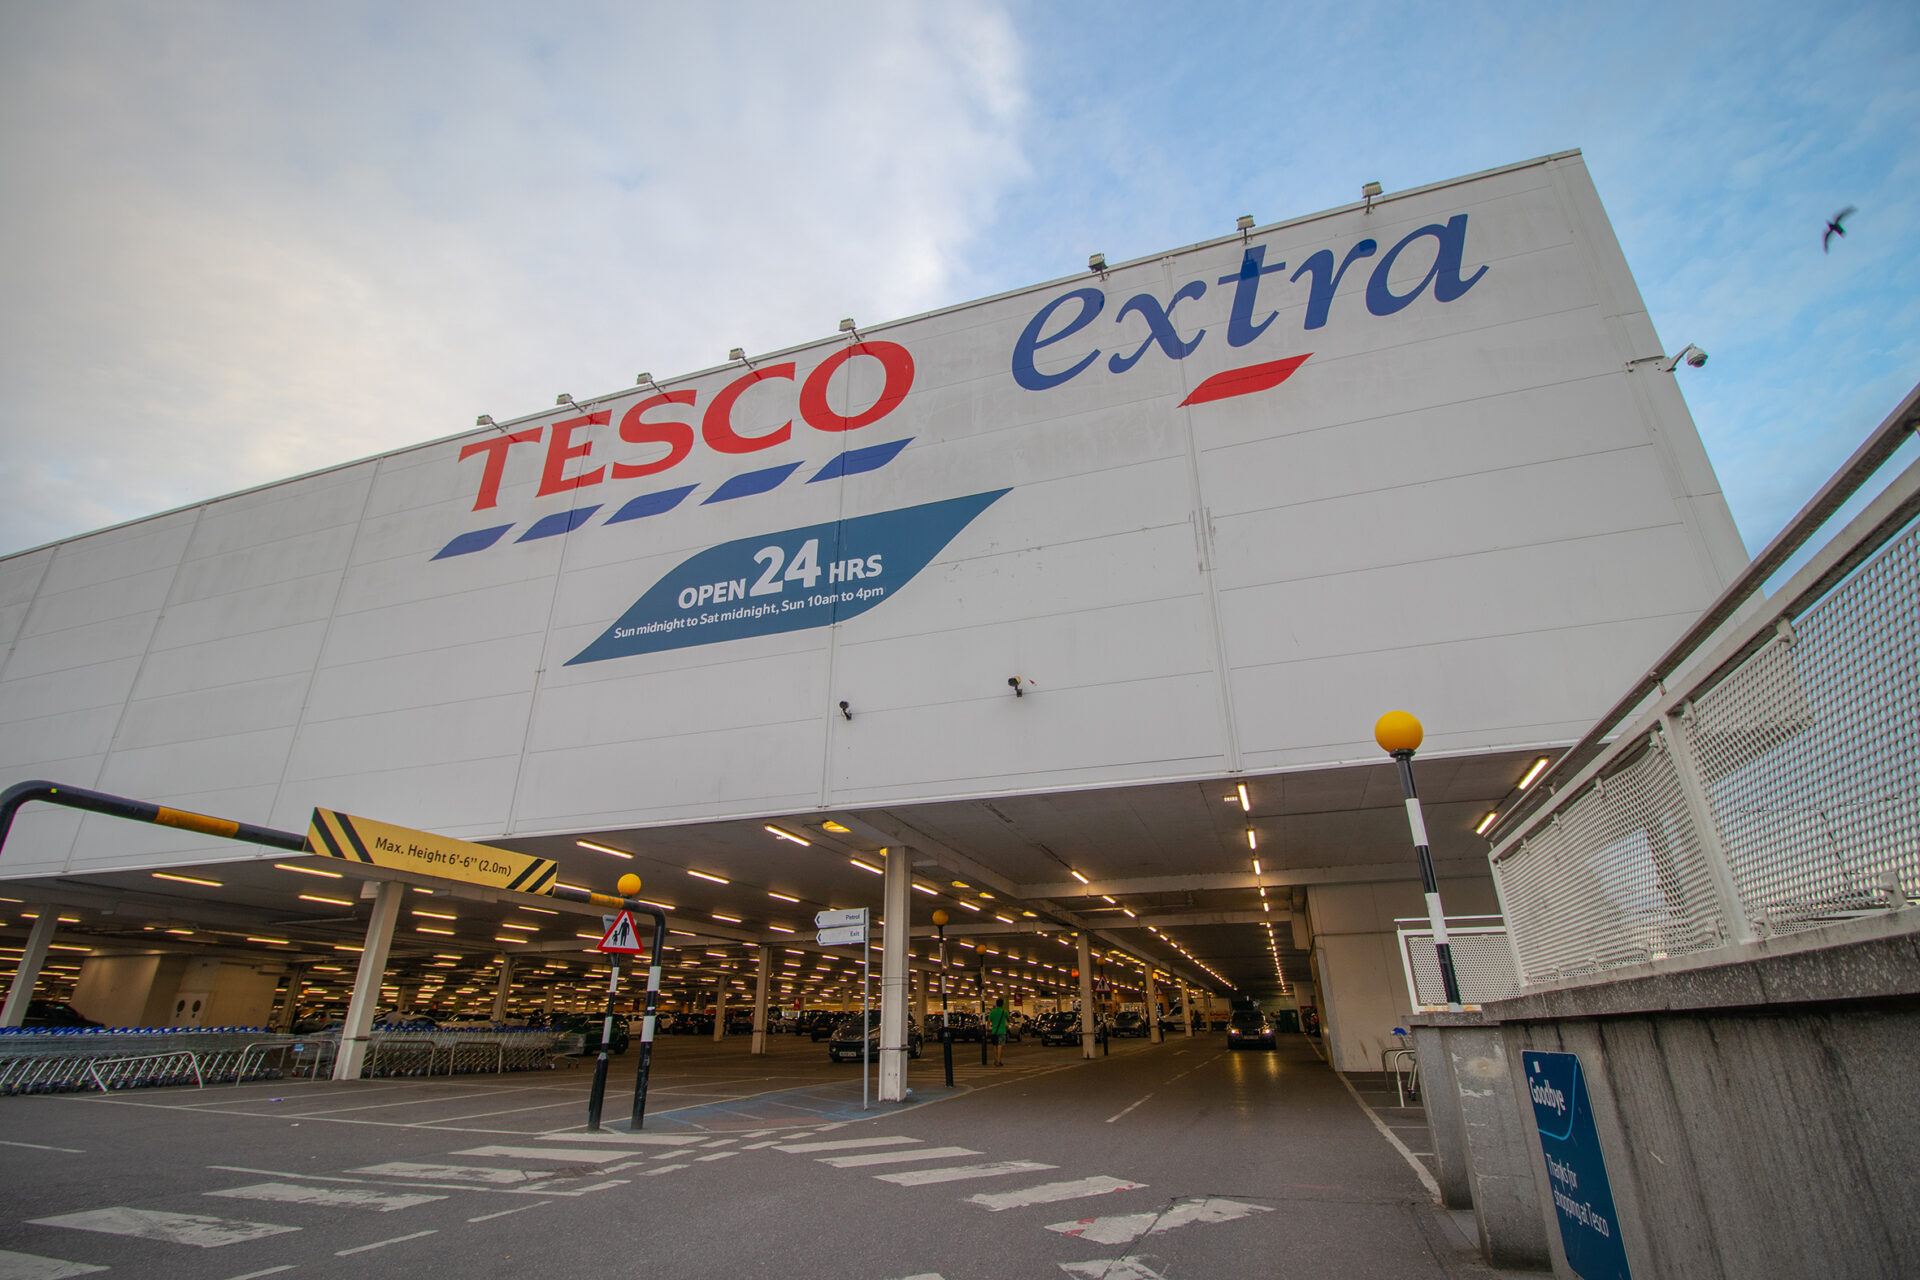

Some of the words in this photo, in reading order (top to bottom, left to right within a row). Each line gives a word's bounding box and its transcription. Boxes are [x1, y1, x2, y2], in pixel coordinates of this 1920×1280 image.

[457, 341, 915, 512] TESCO
[1011, 213, 1490, 391] extra
[678, 578, 747, 609] OPEN
[749, 538, 822, 597] 24
[828, 554, 883, 584] HRS
[613, 627, 636, 639] Sun
[636, 618, 686, 635] midnight
[686, 617, 699, 627] to
[699, 611, 720, 625] Sat
[720, 602, 780, 622] midnight,
[781, 599, 805, 612] Sun
[807, 593, 840, 607] 10am
[841, 590, 855, 602] to
[855, 586, 884, 601] 4pm
[375, 837, 405, 854] Max.
[407, 843, 447, 864] Height
[478, 859, 512, 877] (2.0m)
[1529, 1076, 1566, 1117] Goodbye
[1546, 1152, 1569, 1192] Thanks
[1566, 1162, 1578, 1191] for
[1553, 1184, 1583, 1226] shopping
[1580, 1203, 1590, 1226] at
[1585, 1202, 1609, 1238] Tesco
